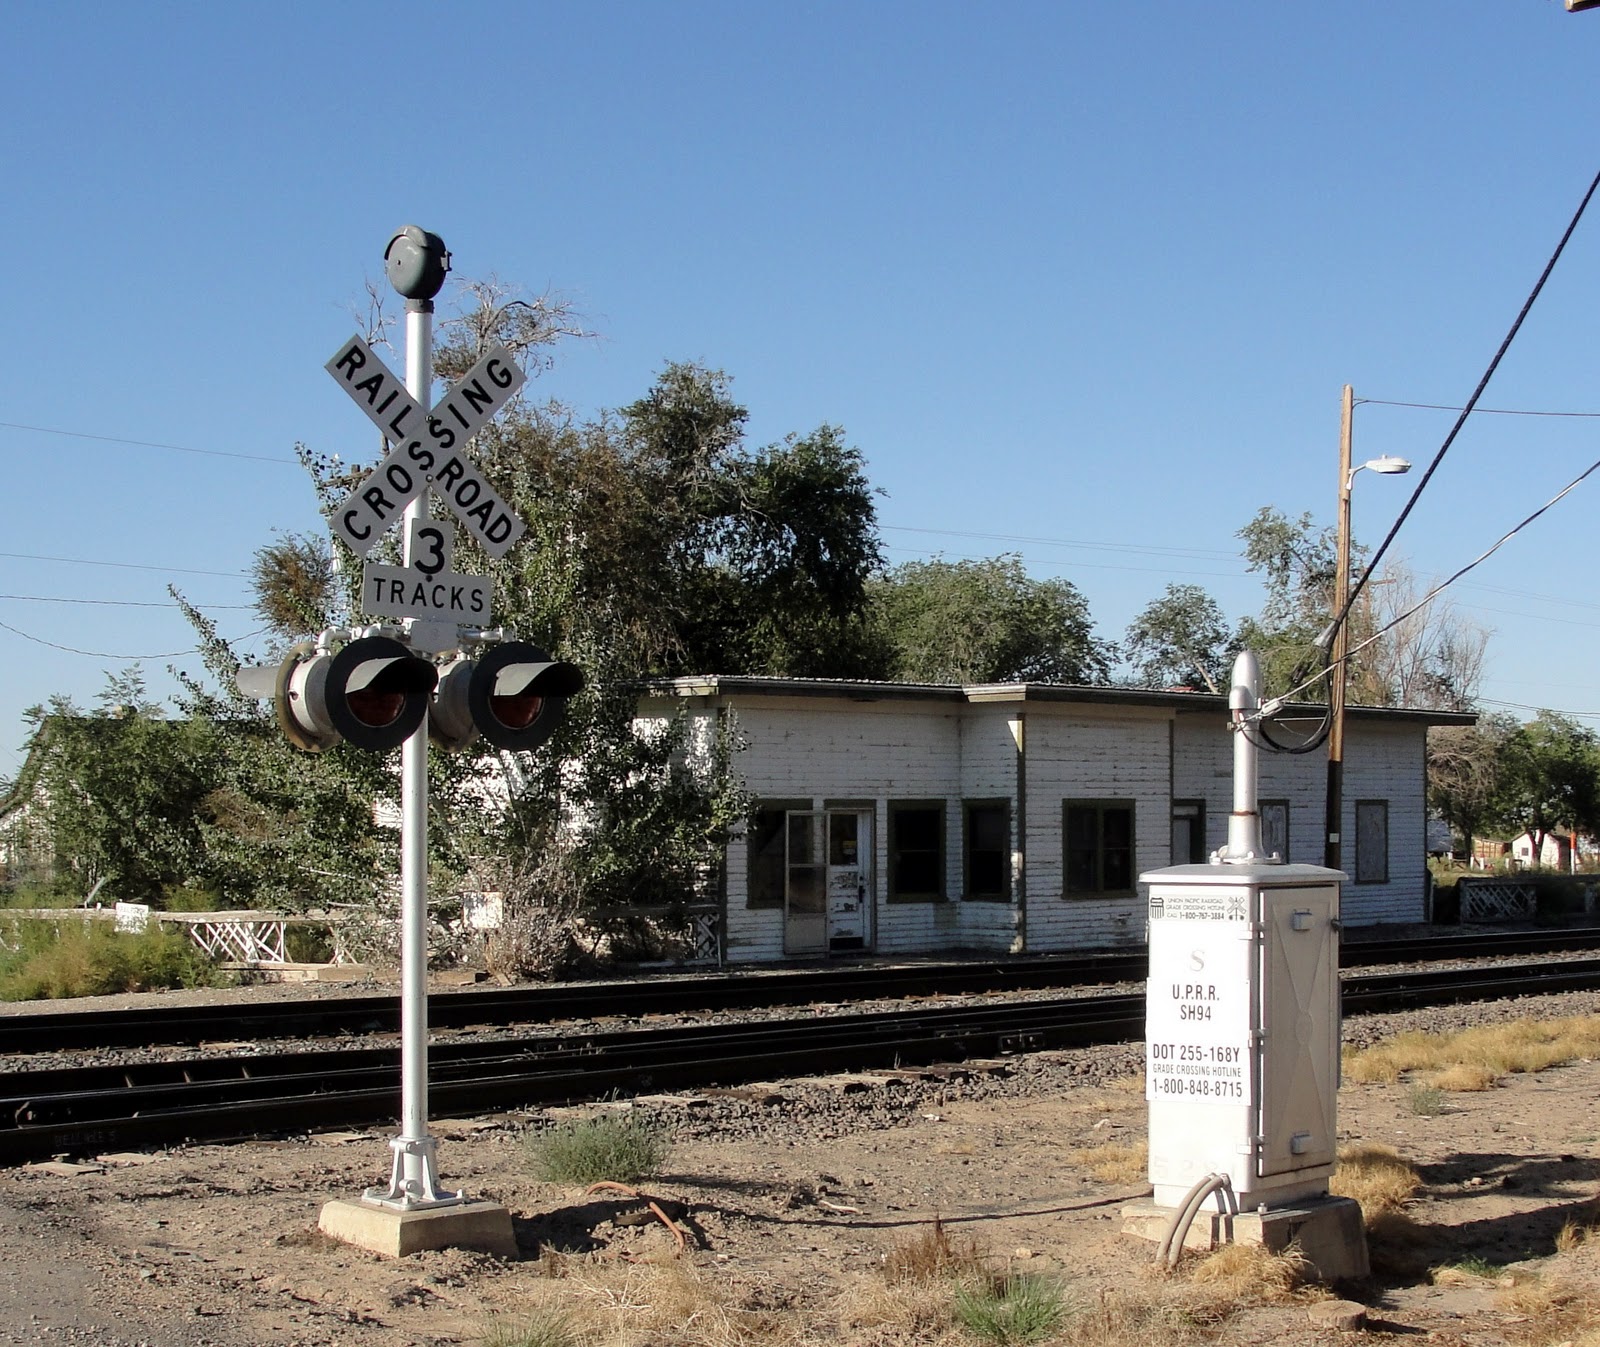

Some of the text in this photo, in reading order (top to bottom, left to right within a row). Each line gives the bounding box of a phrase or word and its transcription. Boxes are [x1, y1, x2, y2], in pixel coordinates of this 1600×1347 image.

[335, 344, 513, 545] RAIL ROAD
[343, 358, 514, 541] CROSSING
[414, 527, 446, 575] 3
[373, 576, 484, 613] TRACKS
[1189, 949, 1206, 973] S
[1172, 983, 1220, 1001] U.P.R.R.
[1180, 1004, 1212, 1021] SH94
[1153, 1043, 1240, 1063] DOT 255-168Y
[1152, 1063, 1242, 1078] GRADE CROSSING HOTLINE
[1153, 1077, 1243, 1098] 1-800-848-8715
